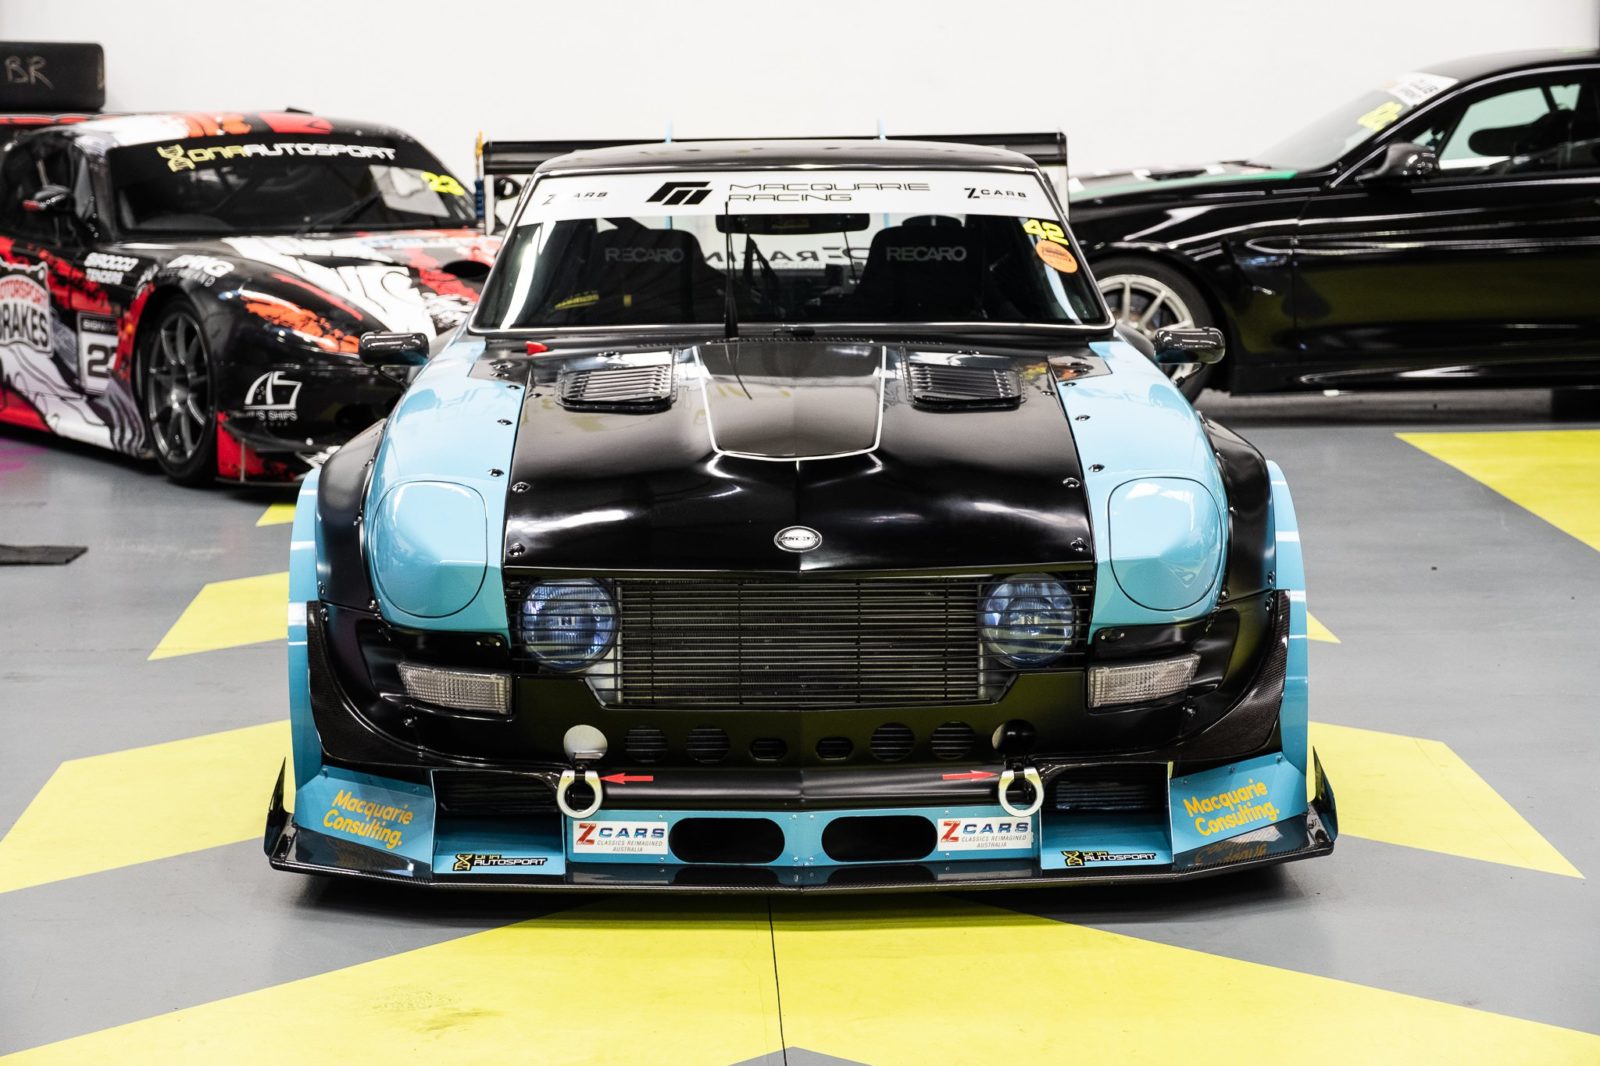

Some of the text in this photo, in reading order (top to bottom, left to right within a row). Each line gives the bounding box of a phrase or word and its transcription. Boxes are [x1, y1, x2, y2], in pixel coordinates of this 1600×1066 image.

[728, 193, 852, 202] RACING
[729, 183, 931, 192] MACQUARIE
[1022, 218, 1070, 246] 42
[604, 247, 684, 262] RECARO
[885, 246, 967, 262] RECARO
[0, 303, 49, 348] RAKES
[332, 790, 414, 825] Macquarie
[1183, 779, 1268, 817] Macquarie
[323, 810, 403, 849] Consulting.
[1195, 801, 1280, 836] Consulting.
[576, 823, 665, 845] Z CARS
[940, 821, 1029, 843] Z CARS
[1083, 854, 1155, 862] AUTOSPORT
